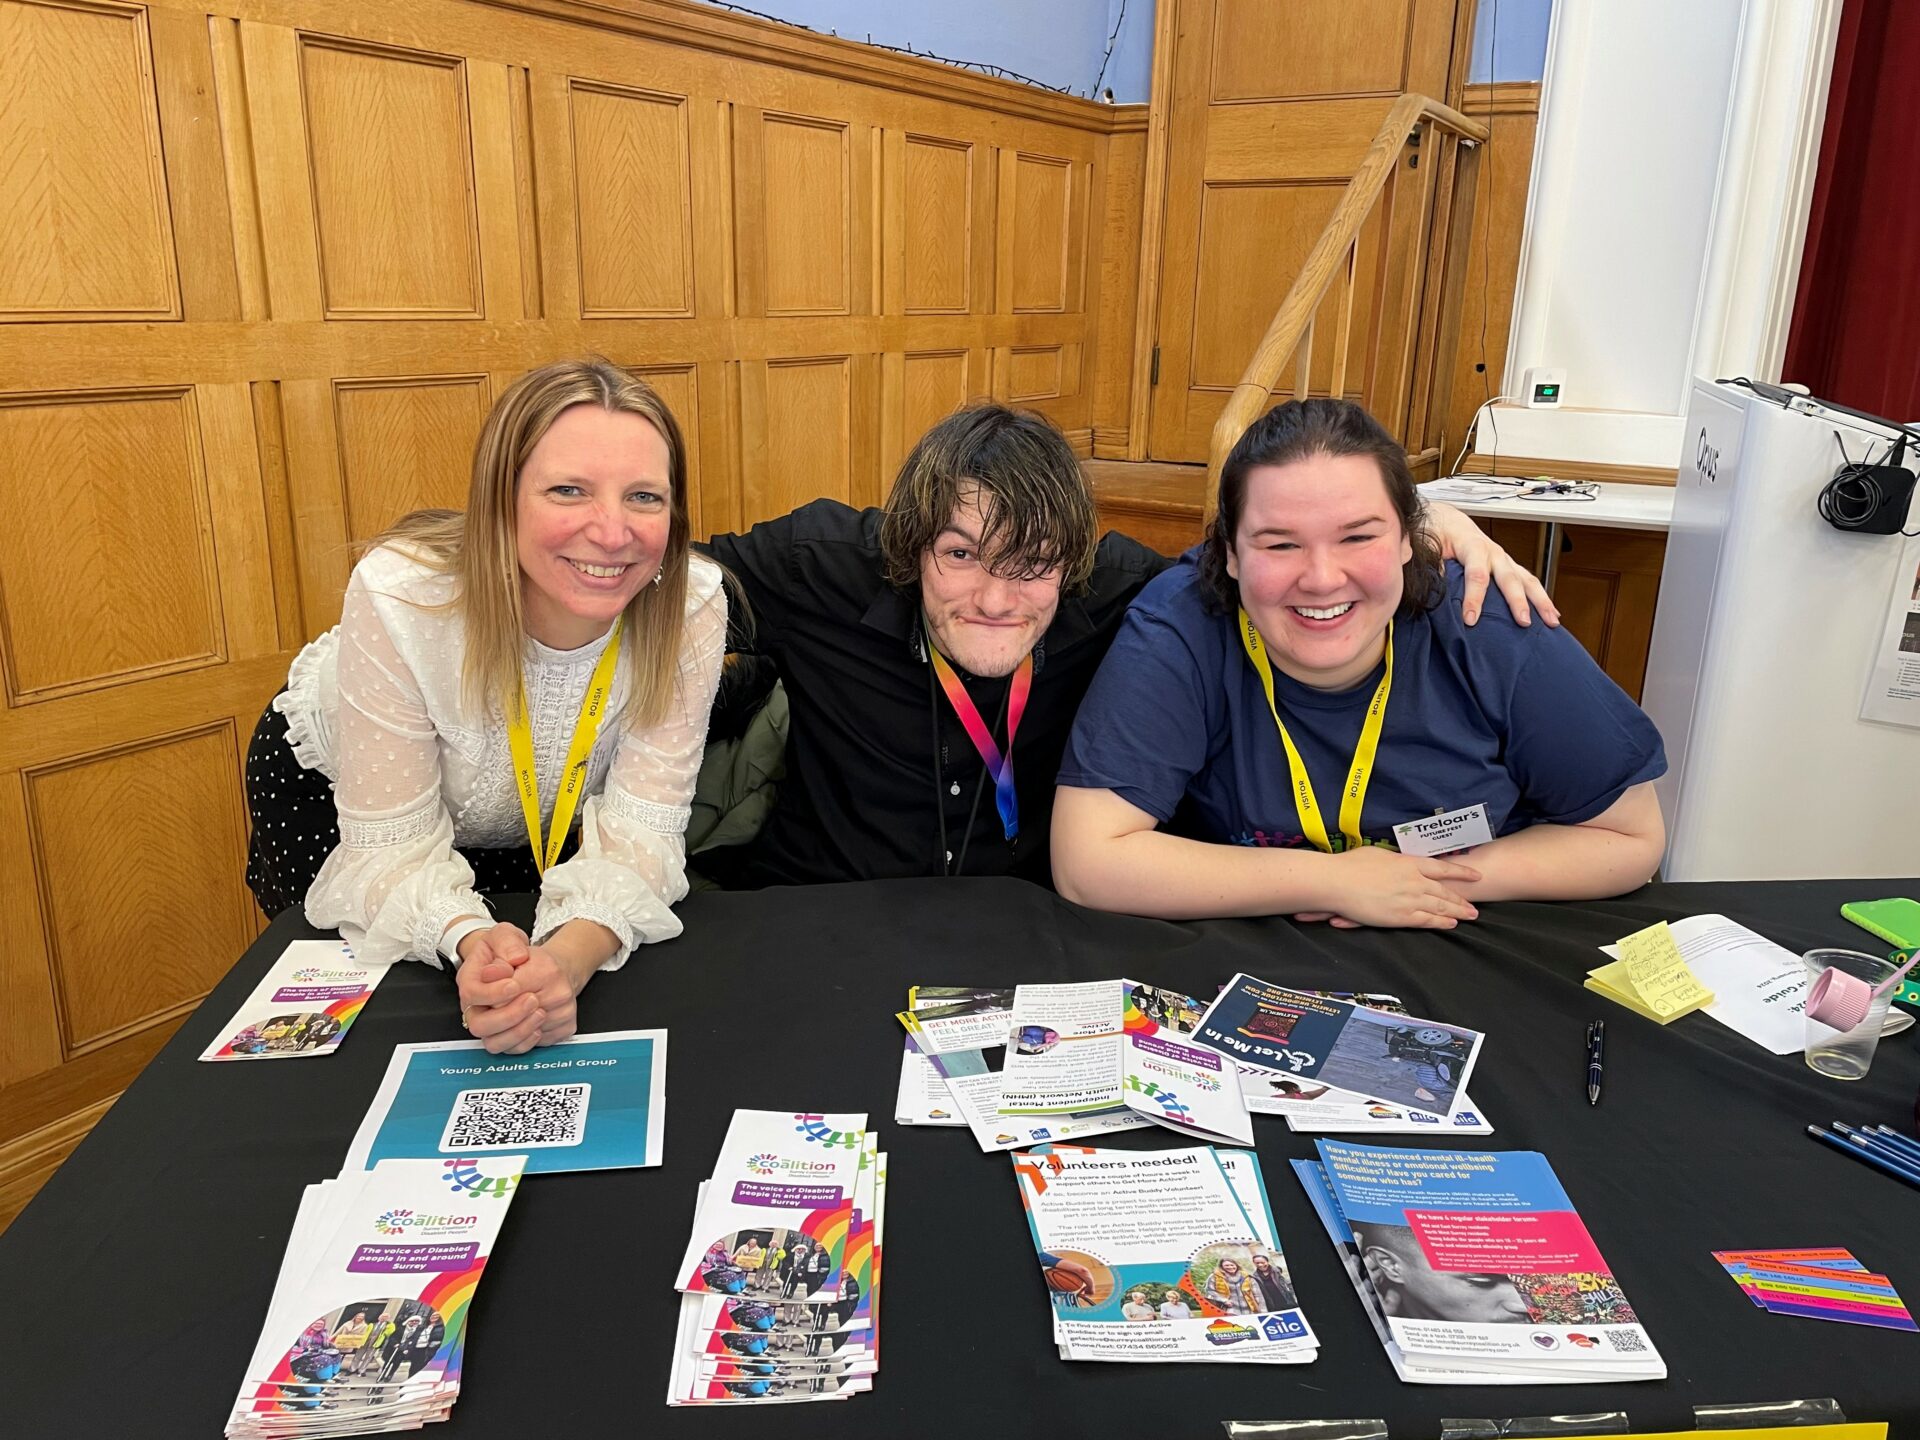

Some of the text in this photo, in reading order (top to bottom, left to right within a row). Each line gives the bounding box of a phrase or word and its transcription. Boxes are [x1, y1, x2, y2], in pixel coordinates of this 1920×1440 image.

[1248, 620, 1257, 650] VISITOR
[588, 688, 603, 717] VISITOR
[1372, 686, 1386, 716] VISITOR
[522, 769, 532, 798] VISITOR
[566, 765, 579, 794] VISITOR
[1350, 768, 1364, 798] VISITOR
[1298, 780, 1311, 810] VISITOR
[1414, 810, 1480, 832] Treloar's
[1420, 828, 1446, 838] FUTURE
[1432, 832, 1453, 840] GUEST
[1762, 986, 1798, 1003] Guide
[950, 1018, 980, 1026] MORE
[932, 1027, 959, 1036] FEEL
[1138, 1044, 1169, 1057] Disabled
[1165, 1042, 1189, 1052] Surrey
[1205, 1028, 1284, 1061] Let Me In
[440, 1058, 617, 1076] Young Adults Social Group
[1191, 1055, 1217, 1064] people
[1143, 1062, 1210, 1085] coalition
[1086, 1086, 1118, 1096] Health
[1047, 1095, 1110, 1106] Independent
[1325, 1144, 1347, 1155] Have
[1367, 1152, 1422, 1161] experienced
[760, 1160, 836, 1170] coalition
[1031, 1155, 1198, 1170] Volunteers needed!
[1330, 1155, 1360, 1165] mental
[1362, 1159, 1391, 1167] illness
[1449, 1164, 1495, 1172] wellbeing
[1333, 1163, 1384, 1175] difficulties?
[1337, 1172, 1378, 1183] someone
[390, 1215, 478, 1226] coalition
[1266, 1321, 1300, 1335] silc
